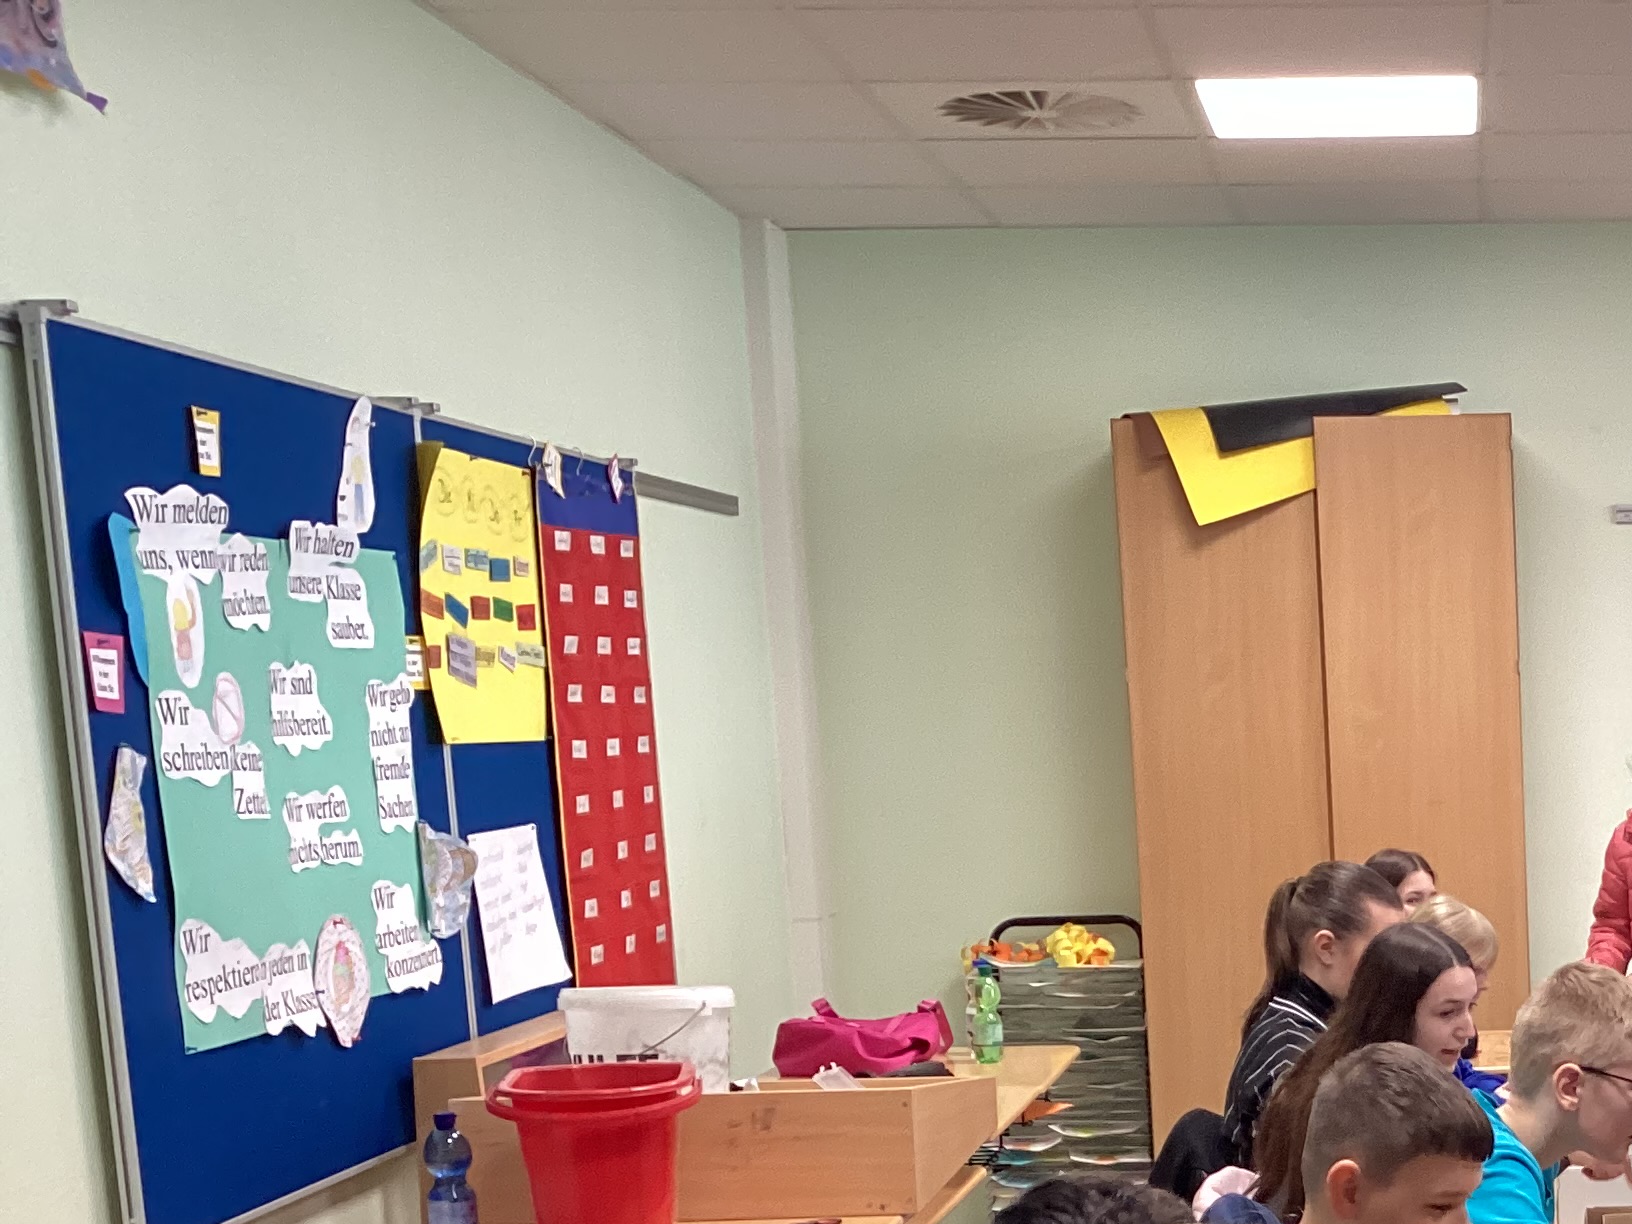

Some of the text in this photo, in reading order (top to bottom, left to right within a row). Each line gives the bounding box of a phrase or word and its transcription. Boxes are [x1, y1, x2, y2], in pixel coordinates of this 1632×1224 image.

[132, 494, 228, 524] Wir melden
[294, 527, 355, 558] Wir halten
[139, 549, 173, 575] uns,
[239, 545, 269, 571] reden
[326, 575, 361, 600] Klasse
[269, 668, 313, 695] Wir sind
[368, 684, 389, 708] Wir
[157, 697, 190, 726] Wir
[371, 721, 397, 747] nicht
[163, 742, 230, 772] schreiben
[376, 755, 411, 781] fremde
[284, 793, 347, 822] Wir werfen
[374, 886, 396, 910] Wir
[183, 926, 211, 955] Wir
[297, 952, 308, 971] in
[265, 995, 282, 1021] der
